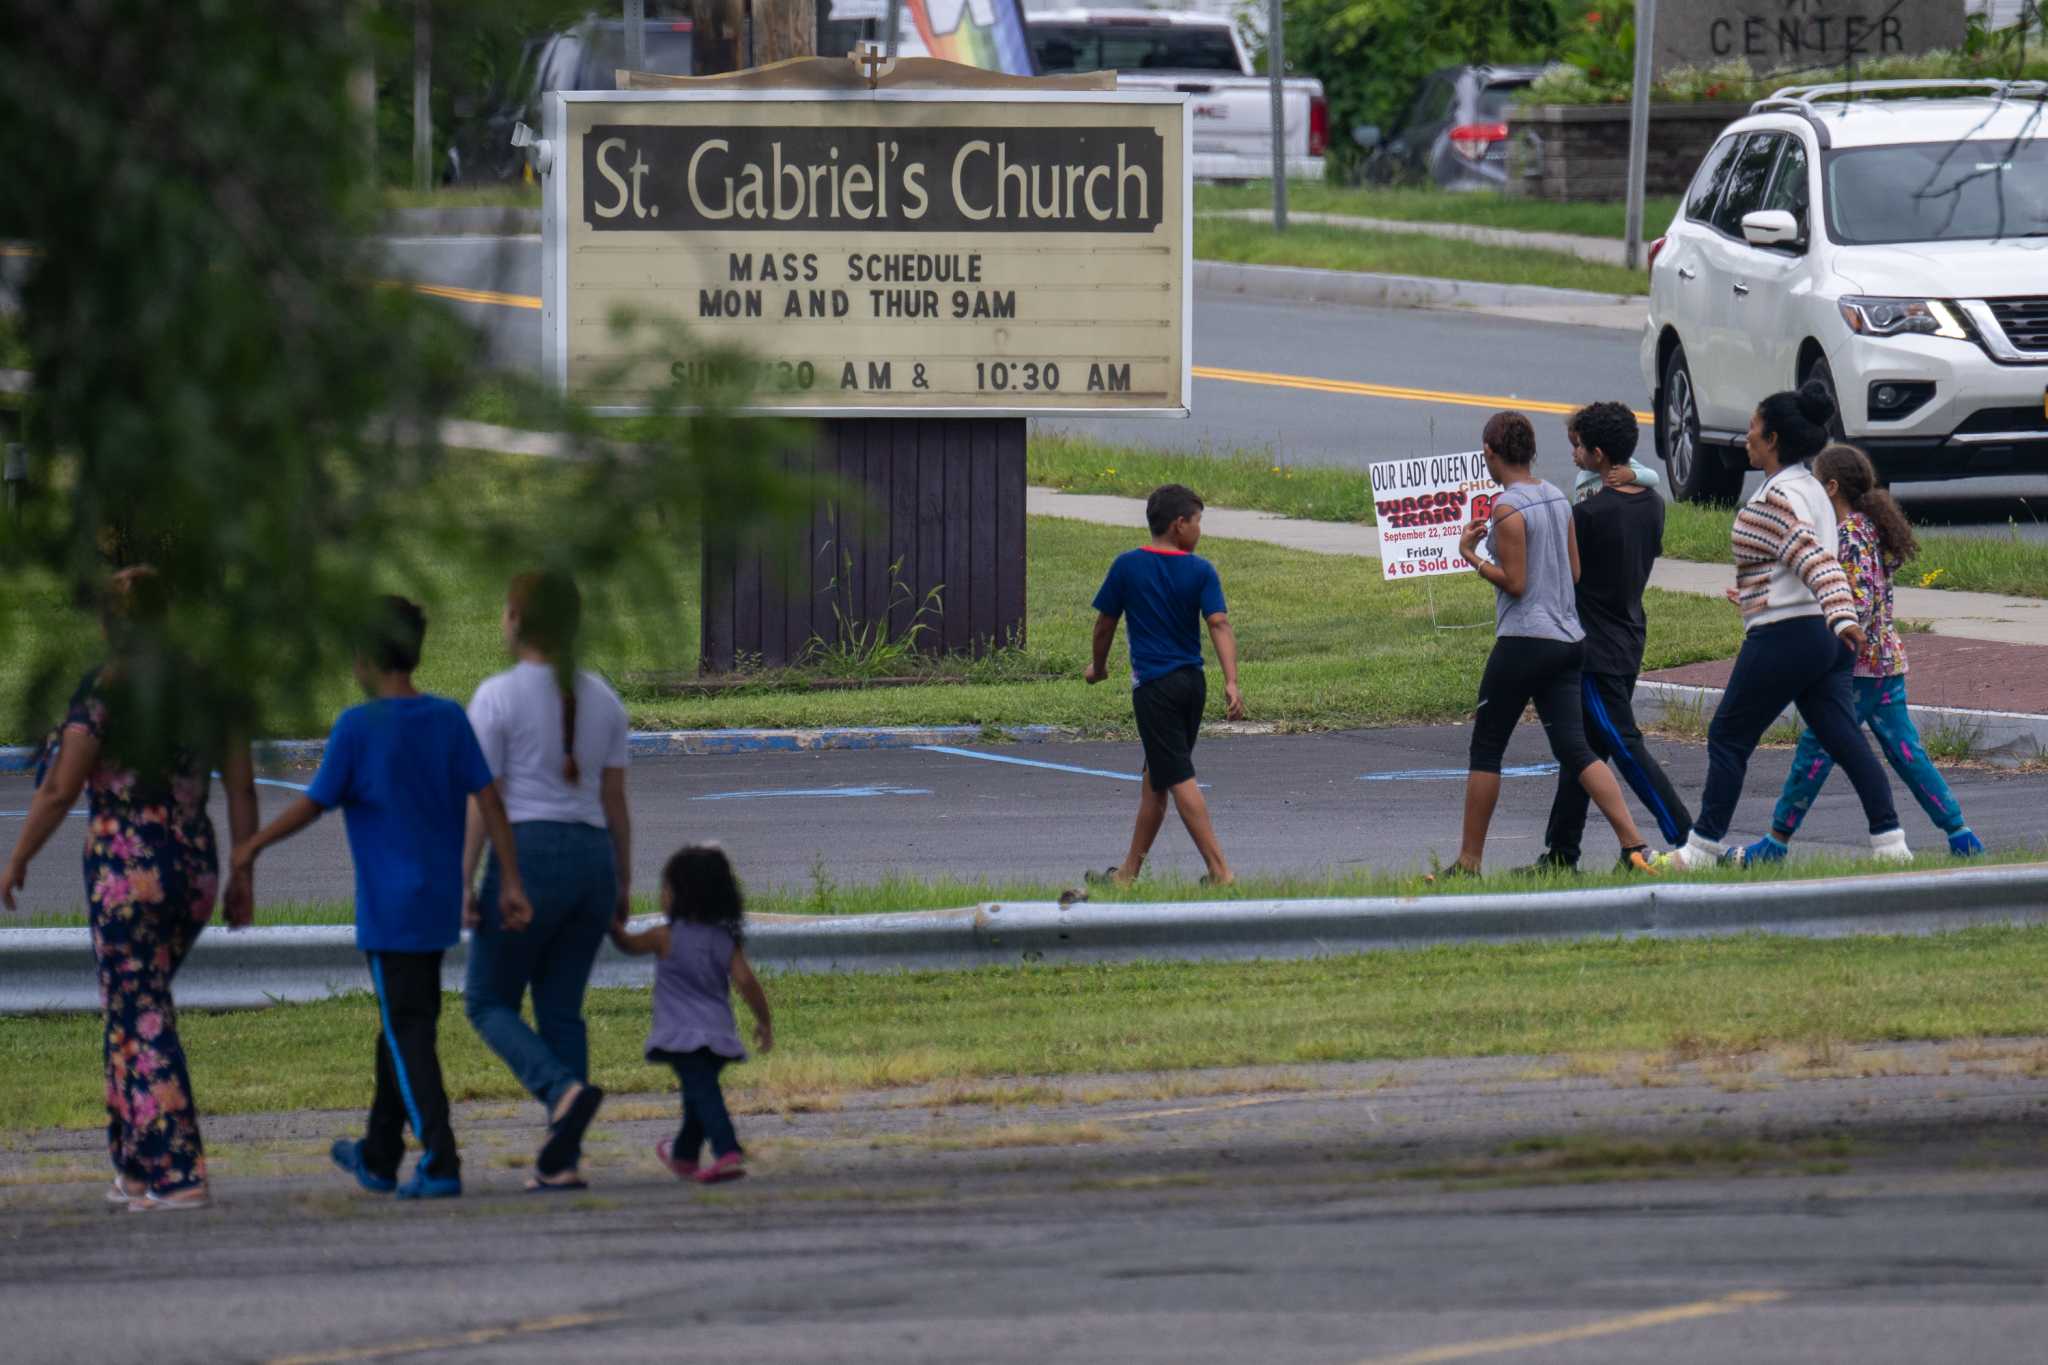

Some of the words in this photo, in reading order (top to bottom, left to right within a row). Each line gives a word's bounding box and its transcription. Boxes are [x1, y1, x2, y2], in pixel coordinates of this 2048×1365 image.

[1709, 16, 1903, 55] CENTER
[594, 137, 660, 220] St.
[687, 138, 929, 221] Gabriel's
[951, 140, 1149, 221] Church
[729, 253, 819, 282] MASS
[847, 254, 982, 282] SCHEDULE
[699, 290, 763, 318] MON
[784, 291, 849, 318] AND
[870, 291, 939, 318] THUR
[951, 291, 1016, 319] 9AM
[840, 361, 891, 390] AM
[911, 362, 930, 390] &
[976, 361, 1060, 391] 10:30
[1086, 363, 1131, 392] AM
[1372, 464, 1396, 491] OUR
[1399, 459, 1429, 488] LADY
[1431, 455, 1468, 488] QUEEN
[1471, 453, 1486, 480] OF
[1376, 491, 1468, 516] WAGON
[1384, 530, 1426, 543] September
[1428, 528, 1441, 540] 22,
[1388, 562, 1397, 576] 4
[1400, 560, 1414, 574] to
[1418, 557, 1448, 572] Sold
[1452, 558, 1474, 570] ou
[1406, 546, 1443, 559] Friday
